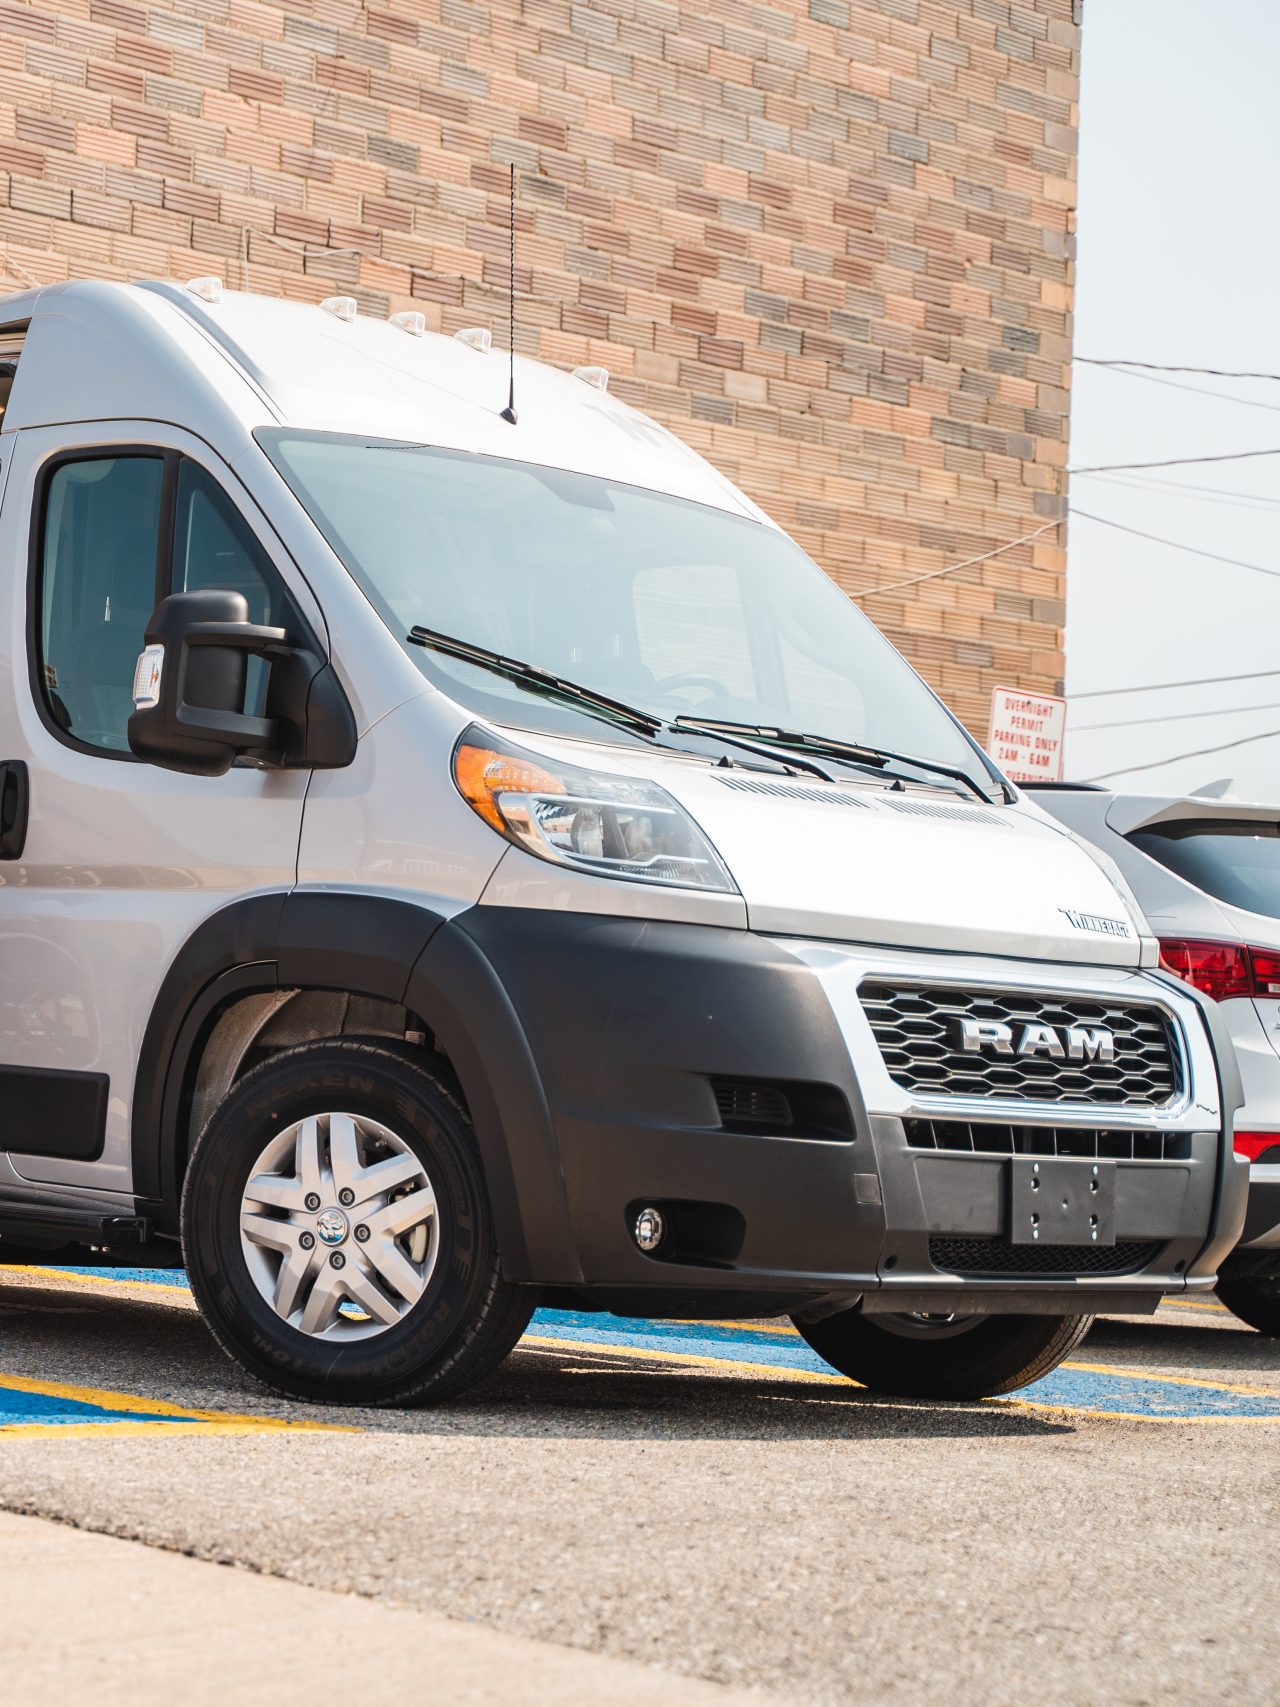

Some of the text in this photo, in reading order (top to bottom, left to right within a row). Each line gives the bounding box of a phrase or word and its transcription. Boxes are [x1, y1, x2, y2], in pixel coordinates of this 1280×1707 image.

[1005, 698, 1053, 718] OVERNIGHT
[1011, 715, 1043, 732] PERMIT
[994, 729, 1058, 751] PARKING ONLY
[999, 747, 1018, 761] 2AM
[961, 1018, 1115, 1062] RAM
